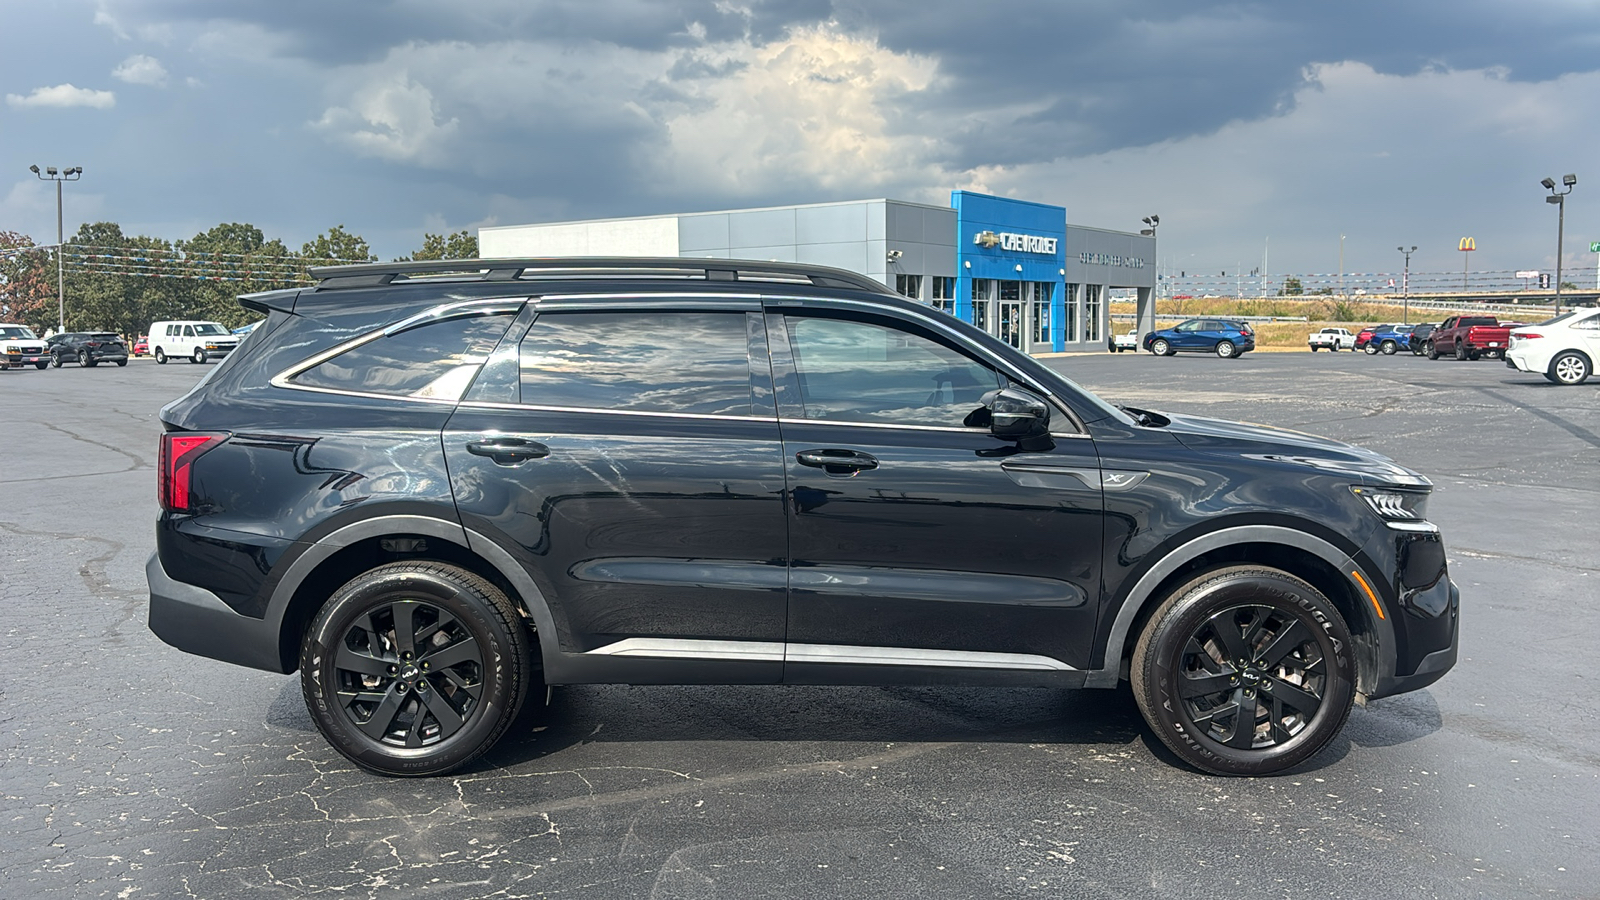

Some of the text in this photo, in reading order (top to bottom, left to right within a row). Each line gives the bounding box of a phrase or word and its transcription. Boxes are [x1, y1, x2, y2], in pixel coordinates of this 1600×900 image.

[1000, 232, 1058, 255] CHEVROLET
[1266, 585, 1348, 669] DOUGLAS
[311, 653, 353, 748] DOUGLAS
